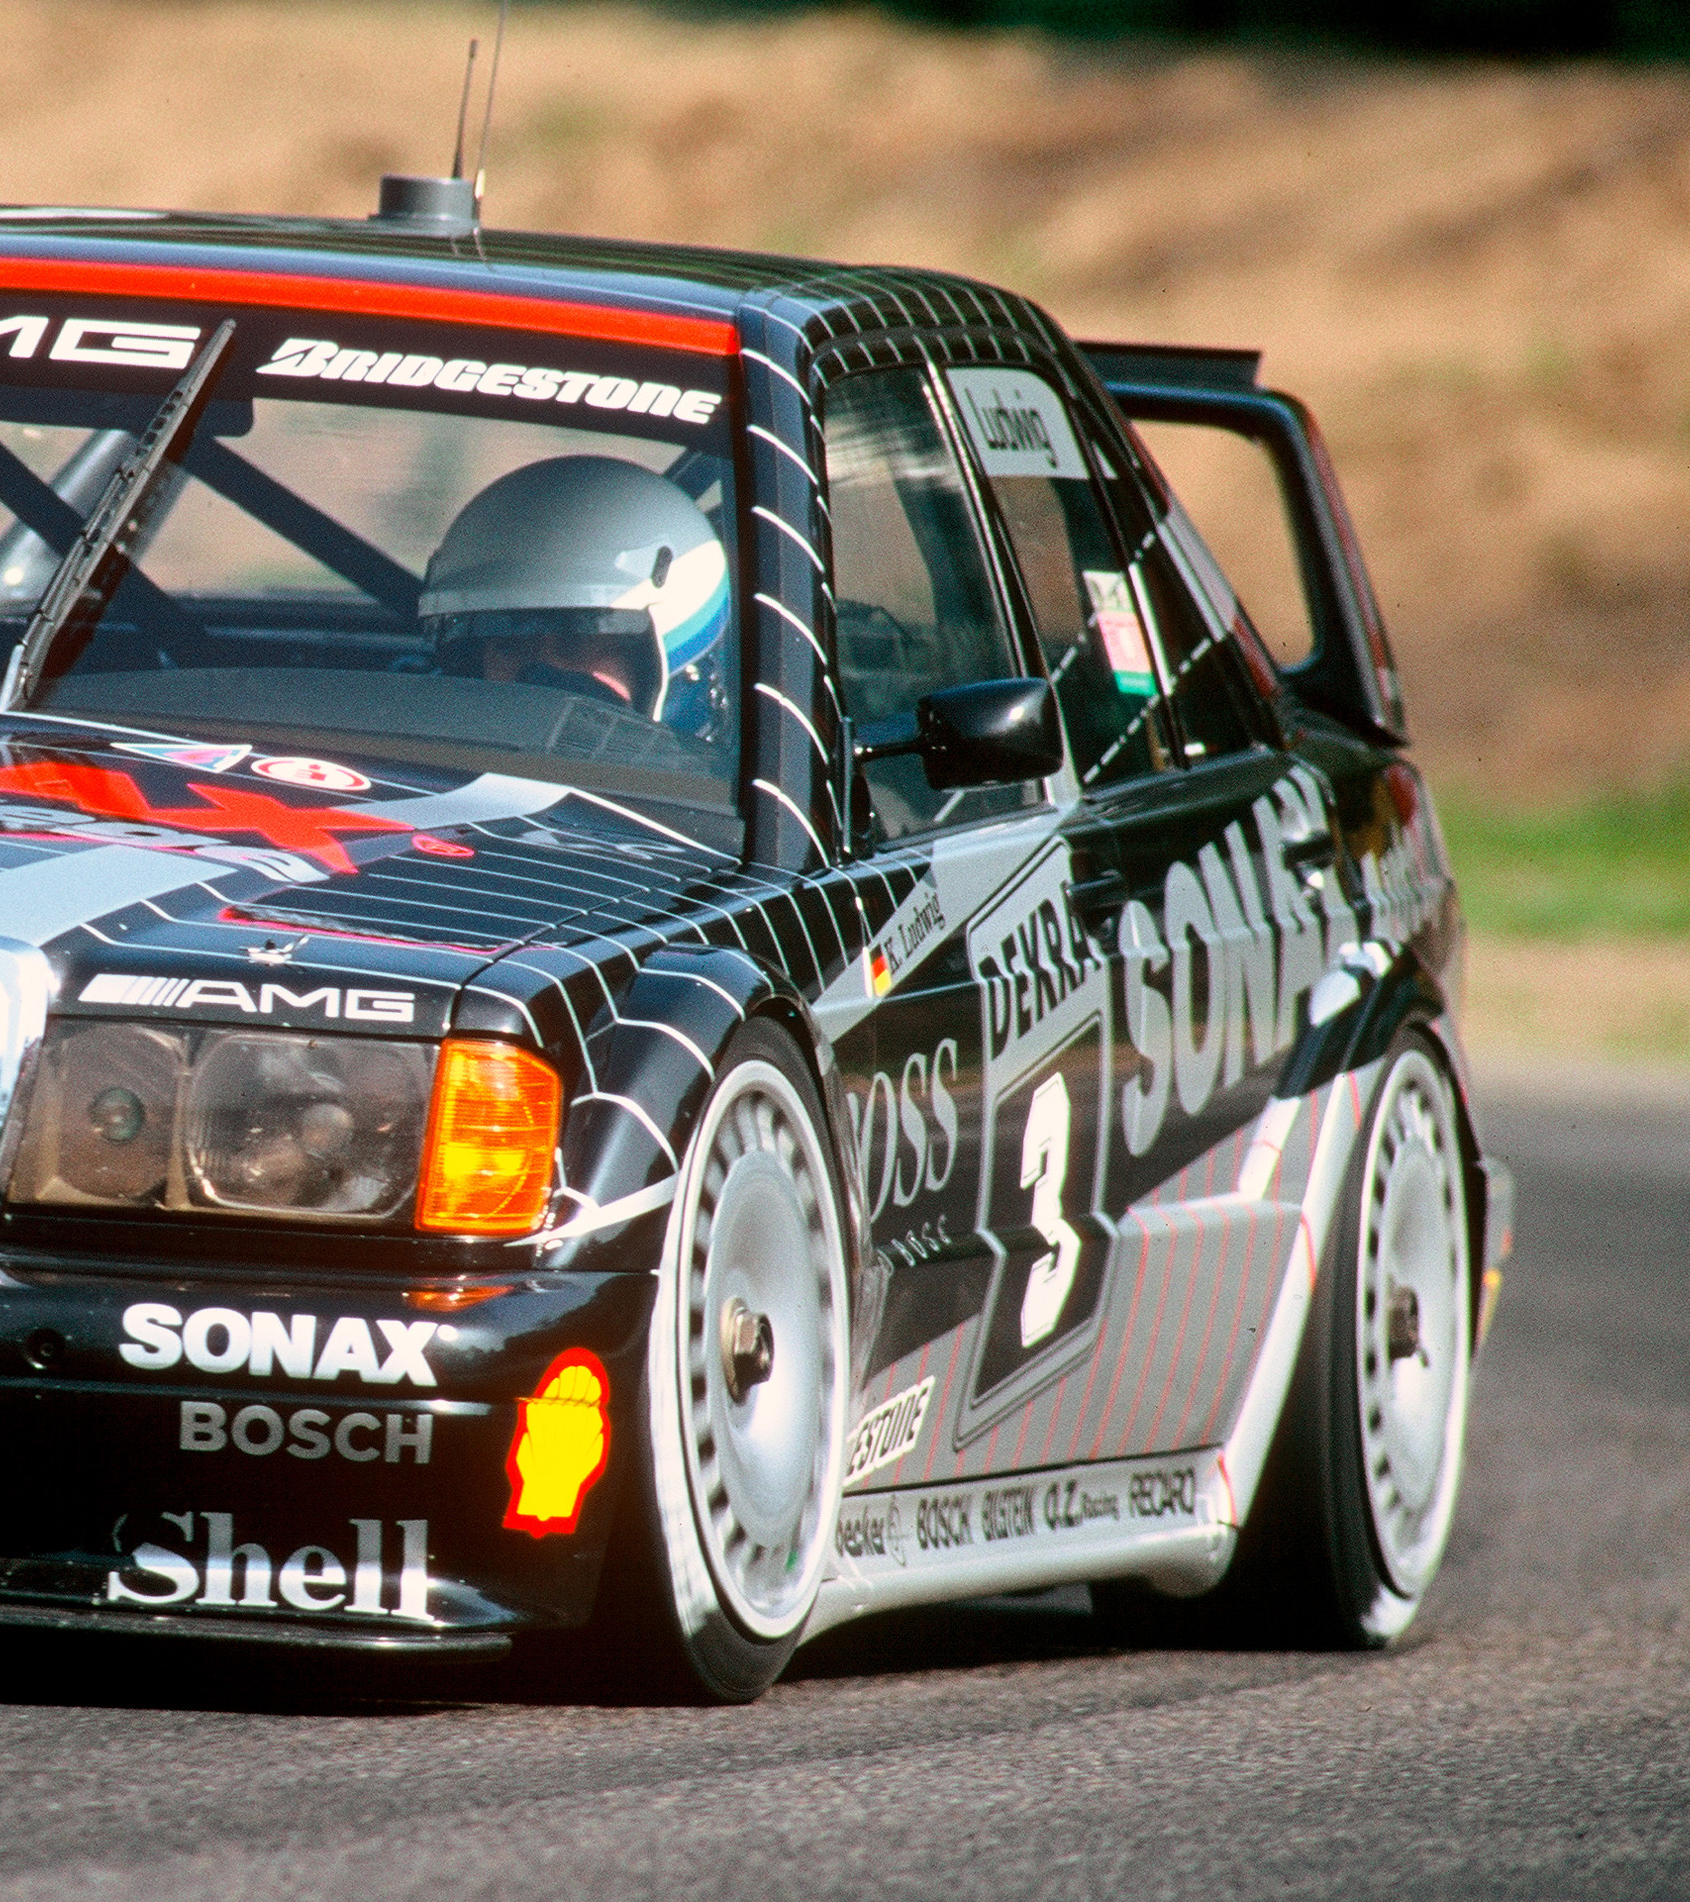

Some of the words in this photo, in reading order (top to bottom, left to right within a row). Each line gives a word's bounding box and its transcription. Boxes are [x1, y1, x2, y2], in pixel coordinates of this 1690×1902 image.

[257, 338, 722, 424] BRIDGESTONE
[964, 387, 1058, 469] Ludwig
[883, 936, 903, 976] K.
[898, 891, 947, 960] Ludwig
[978, 880, 1102, 1060] DEKRA
[175, 980, 415, 1022] AMG
[847, 1038, 958, 1223] OSS
[1020, 1071, 1082, 1348] 3
[118, 1303, 438, 1387] SONAX
[179, 1401, 434, 1464] BOSCH
[916, 1493, 974, 1550] BOSCH
[108, 1510, 436, 1621] Shell
